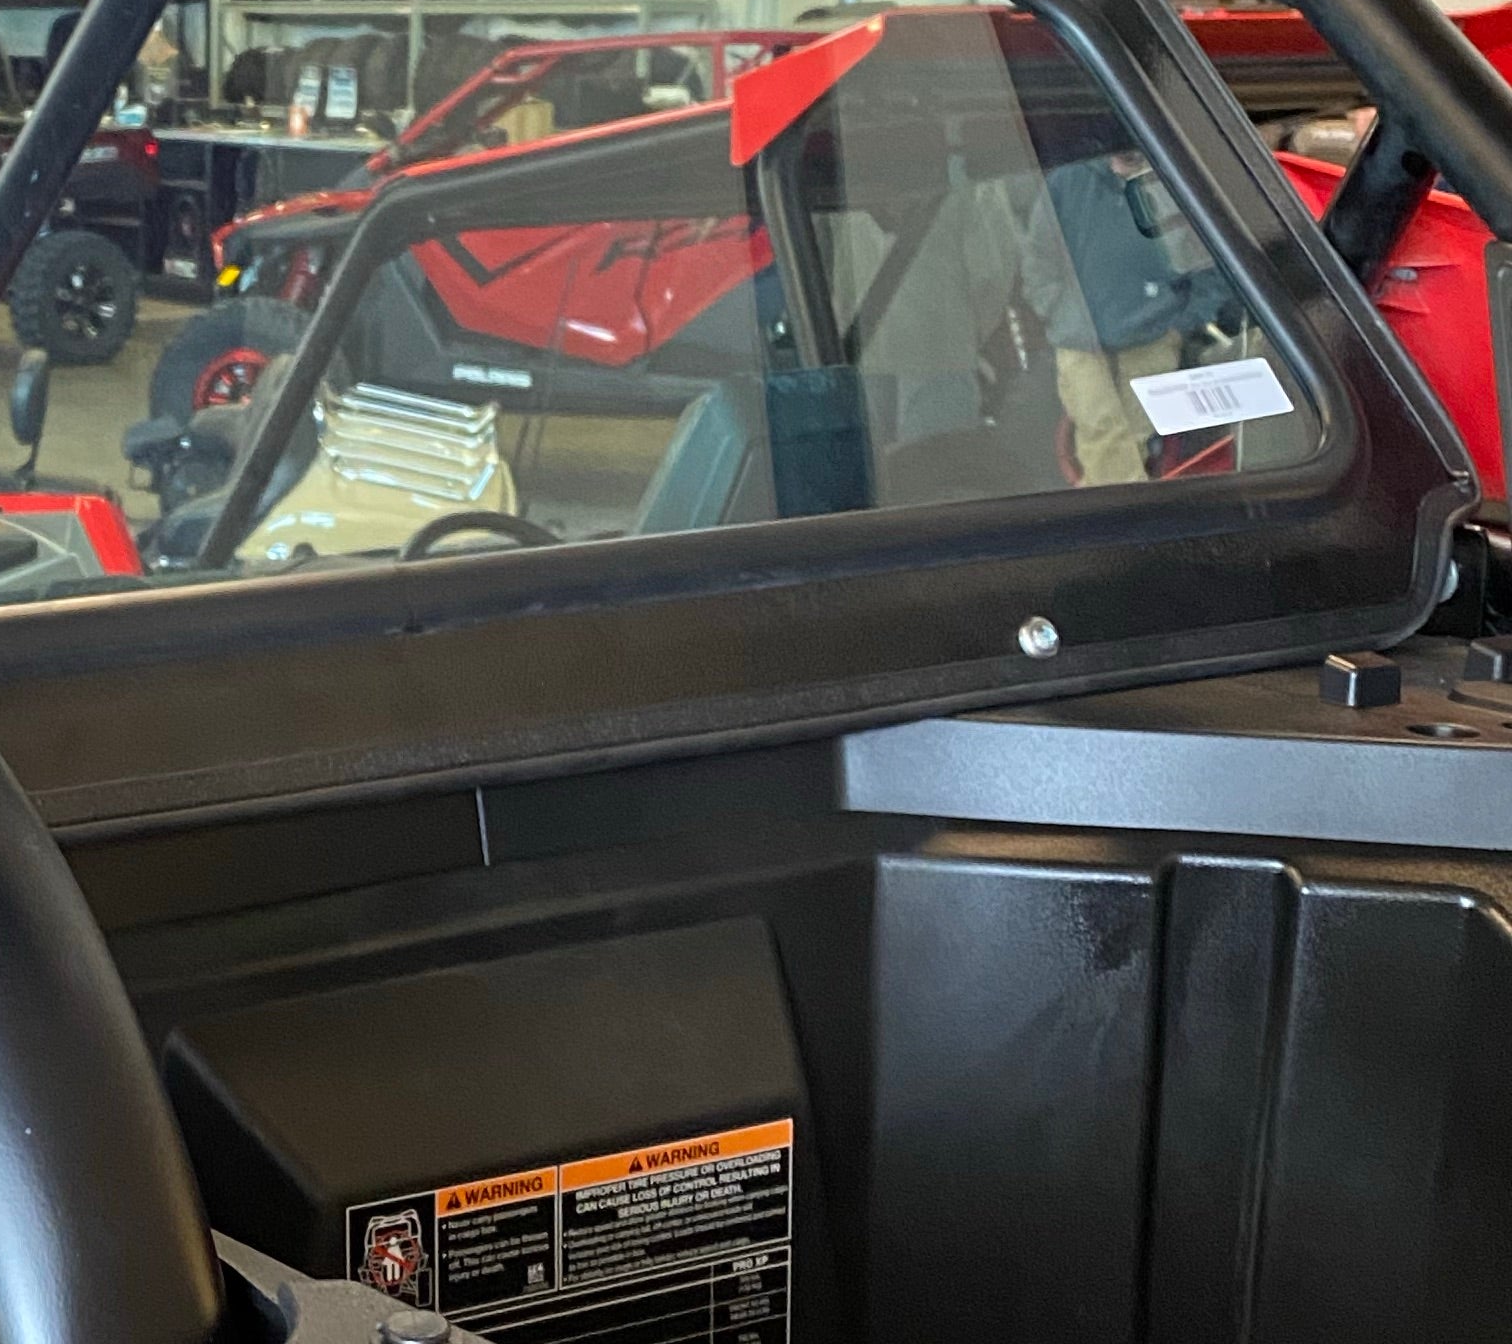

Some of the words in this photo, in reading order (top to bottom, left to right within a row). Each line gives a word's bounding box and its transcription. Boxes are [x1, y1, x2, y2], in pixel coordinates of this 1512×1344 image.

[646, 1142, 720, 1169] WARNING
[575, 1182, 626, 1201] IMPROPER
[628, 1177, 649, 1190] TIRE
[650, 1168, 699, 1185] PRESSURE
[701, 1164, 715, 1174] OR
[715, 1150, 782, 1173] OVERLOADING
[575, 1202, 598, 1214] CAN
[598, 1196, 631, 1210] CAUSE
[632, 1189, 657, 1203] LOSS
[659, 1185, 672, 1196] OF
[672, 1177, 717, 1194] CONTROL
[719, 1165, 769, 1184] RESULTING
[770, 1163, 781, 1173] IN
[465, 1176, 544, 1205] WARNING
[617, 1201, 659, 1218] SERIOUS
[660, 1194, 693, 1209] INJURY
[695, 1190, 709, 1202] OR
[732, 1257, 753, 1272] PRO
[755, 1255, 769, 1267] XP
